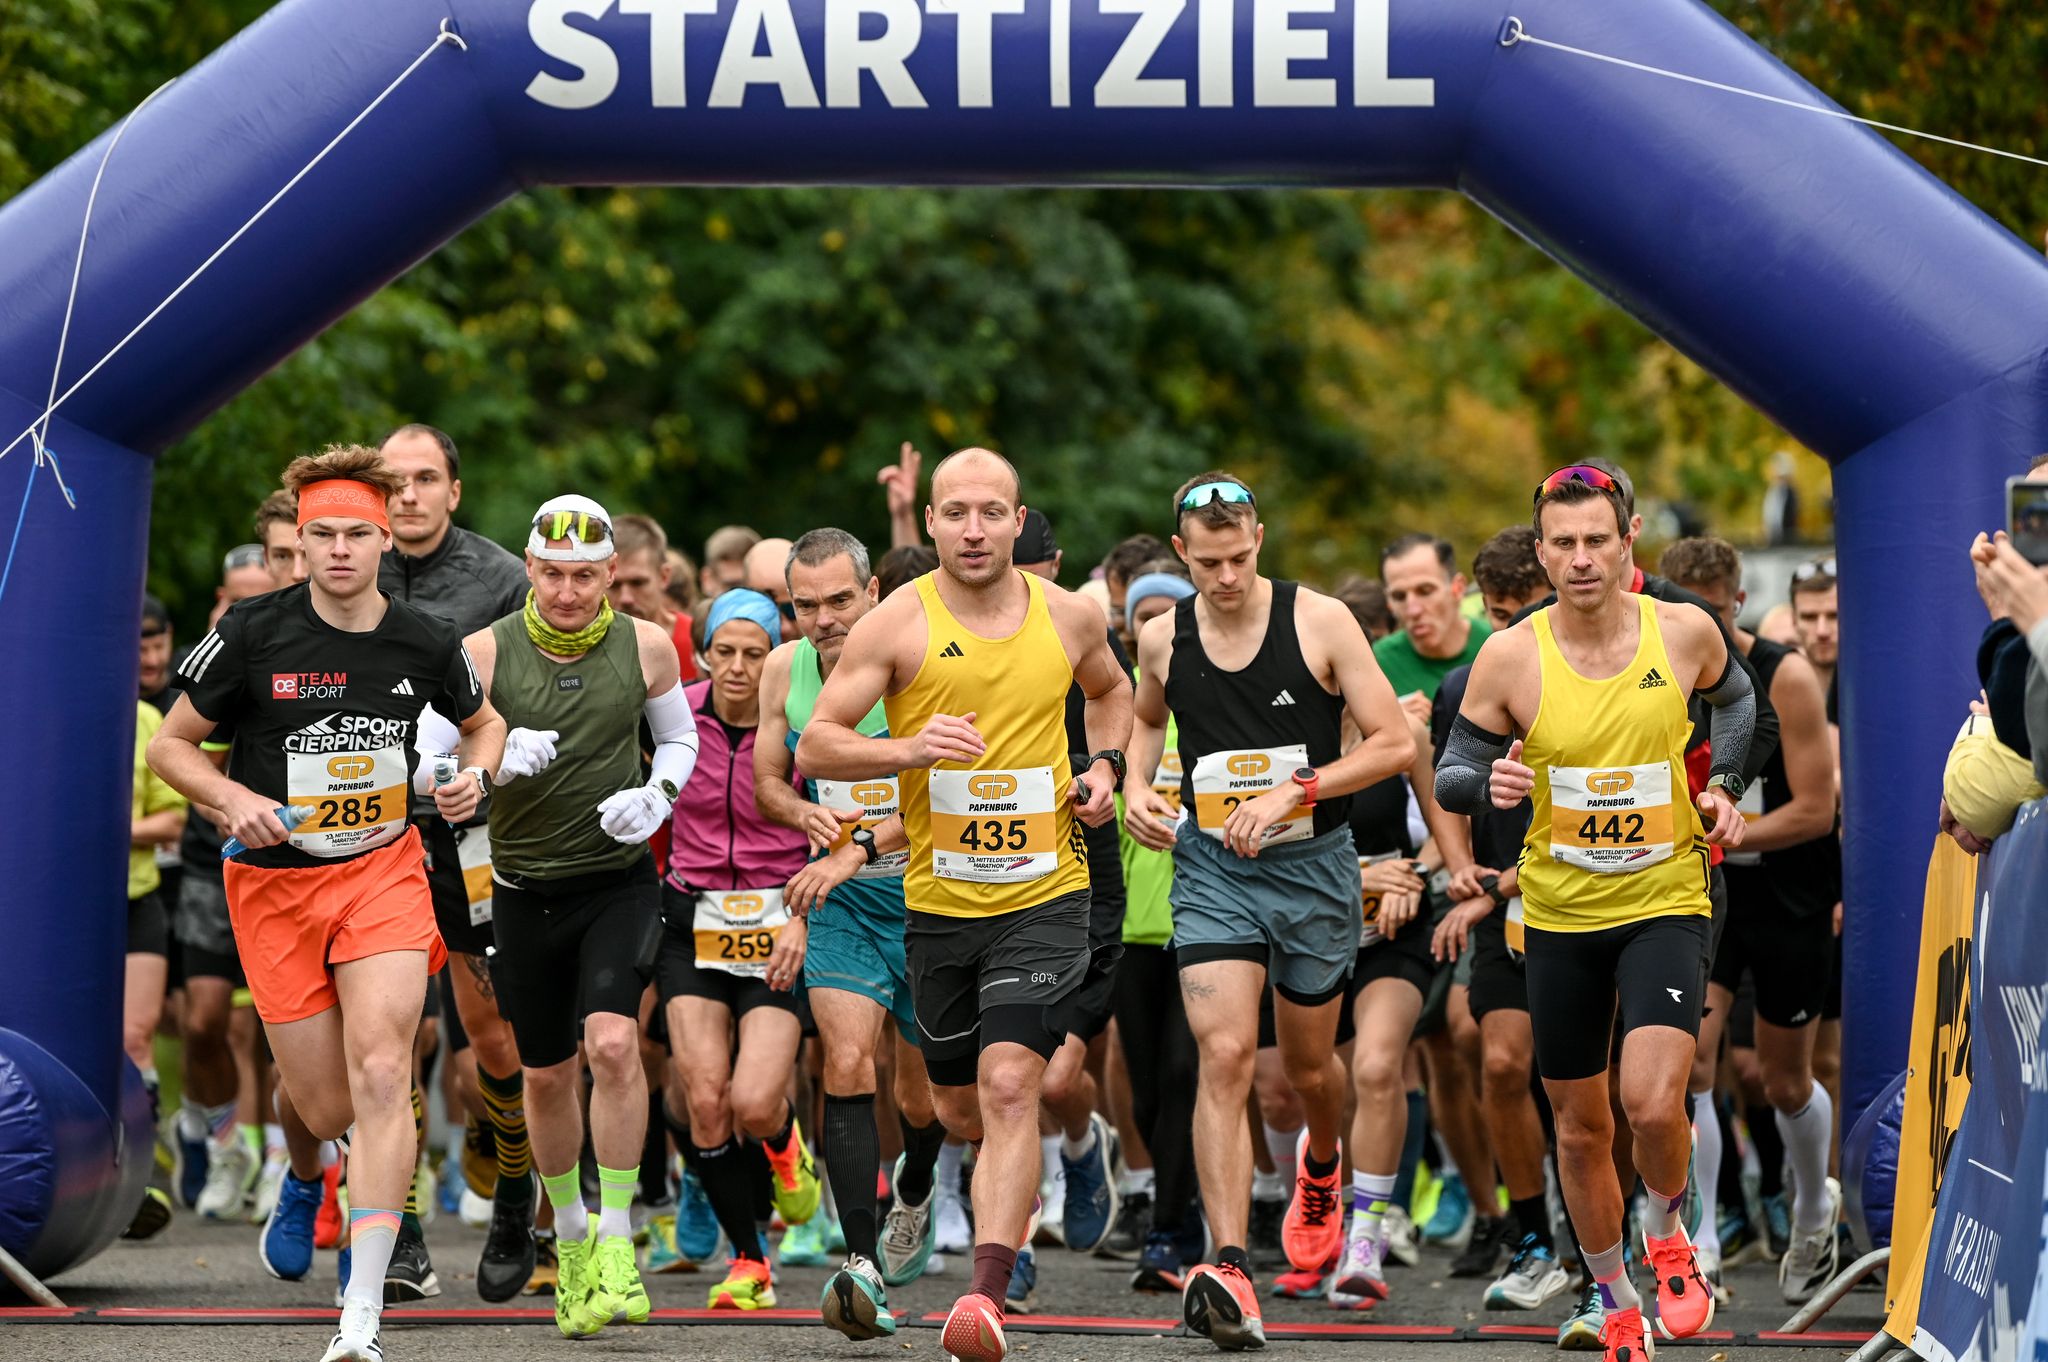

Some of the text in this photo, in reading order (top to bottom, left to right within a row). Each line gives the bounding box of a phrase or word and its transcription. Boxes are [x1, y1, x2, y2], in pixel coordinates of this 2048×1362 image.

[525, 0, 1436, 109] START ZIEL
[298, 672, 347, 685] TEAM
[560, 679, 580, 687] GORE
[1639, 680, 1667, 690] adidas
[298, 686, 347, 699] SPORT
[339, 716, 411, 738] SPORT
[328, 781, 374, 792] PAPENBURG
[1229, 779, 1273, 788] PAPENBURG
[969, 802, 1018, 812] PAPENBURG
[1587, 797, 1635, 807] PAPENBURG
[318, 794, 382, 828] 285
[864, 807, 898, 817] PENBURG
[960, 820, 1027, 851] 435
[1578, 814, 1645, 844] 442
[331, 836, 361, 844] MARATHON
[718, 932, 774, 959] 259
[1031, 972, 1058, 985] GORE
